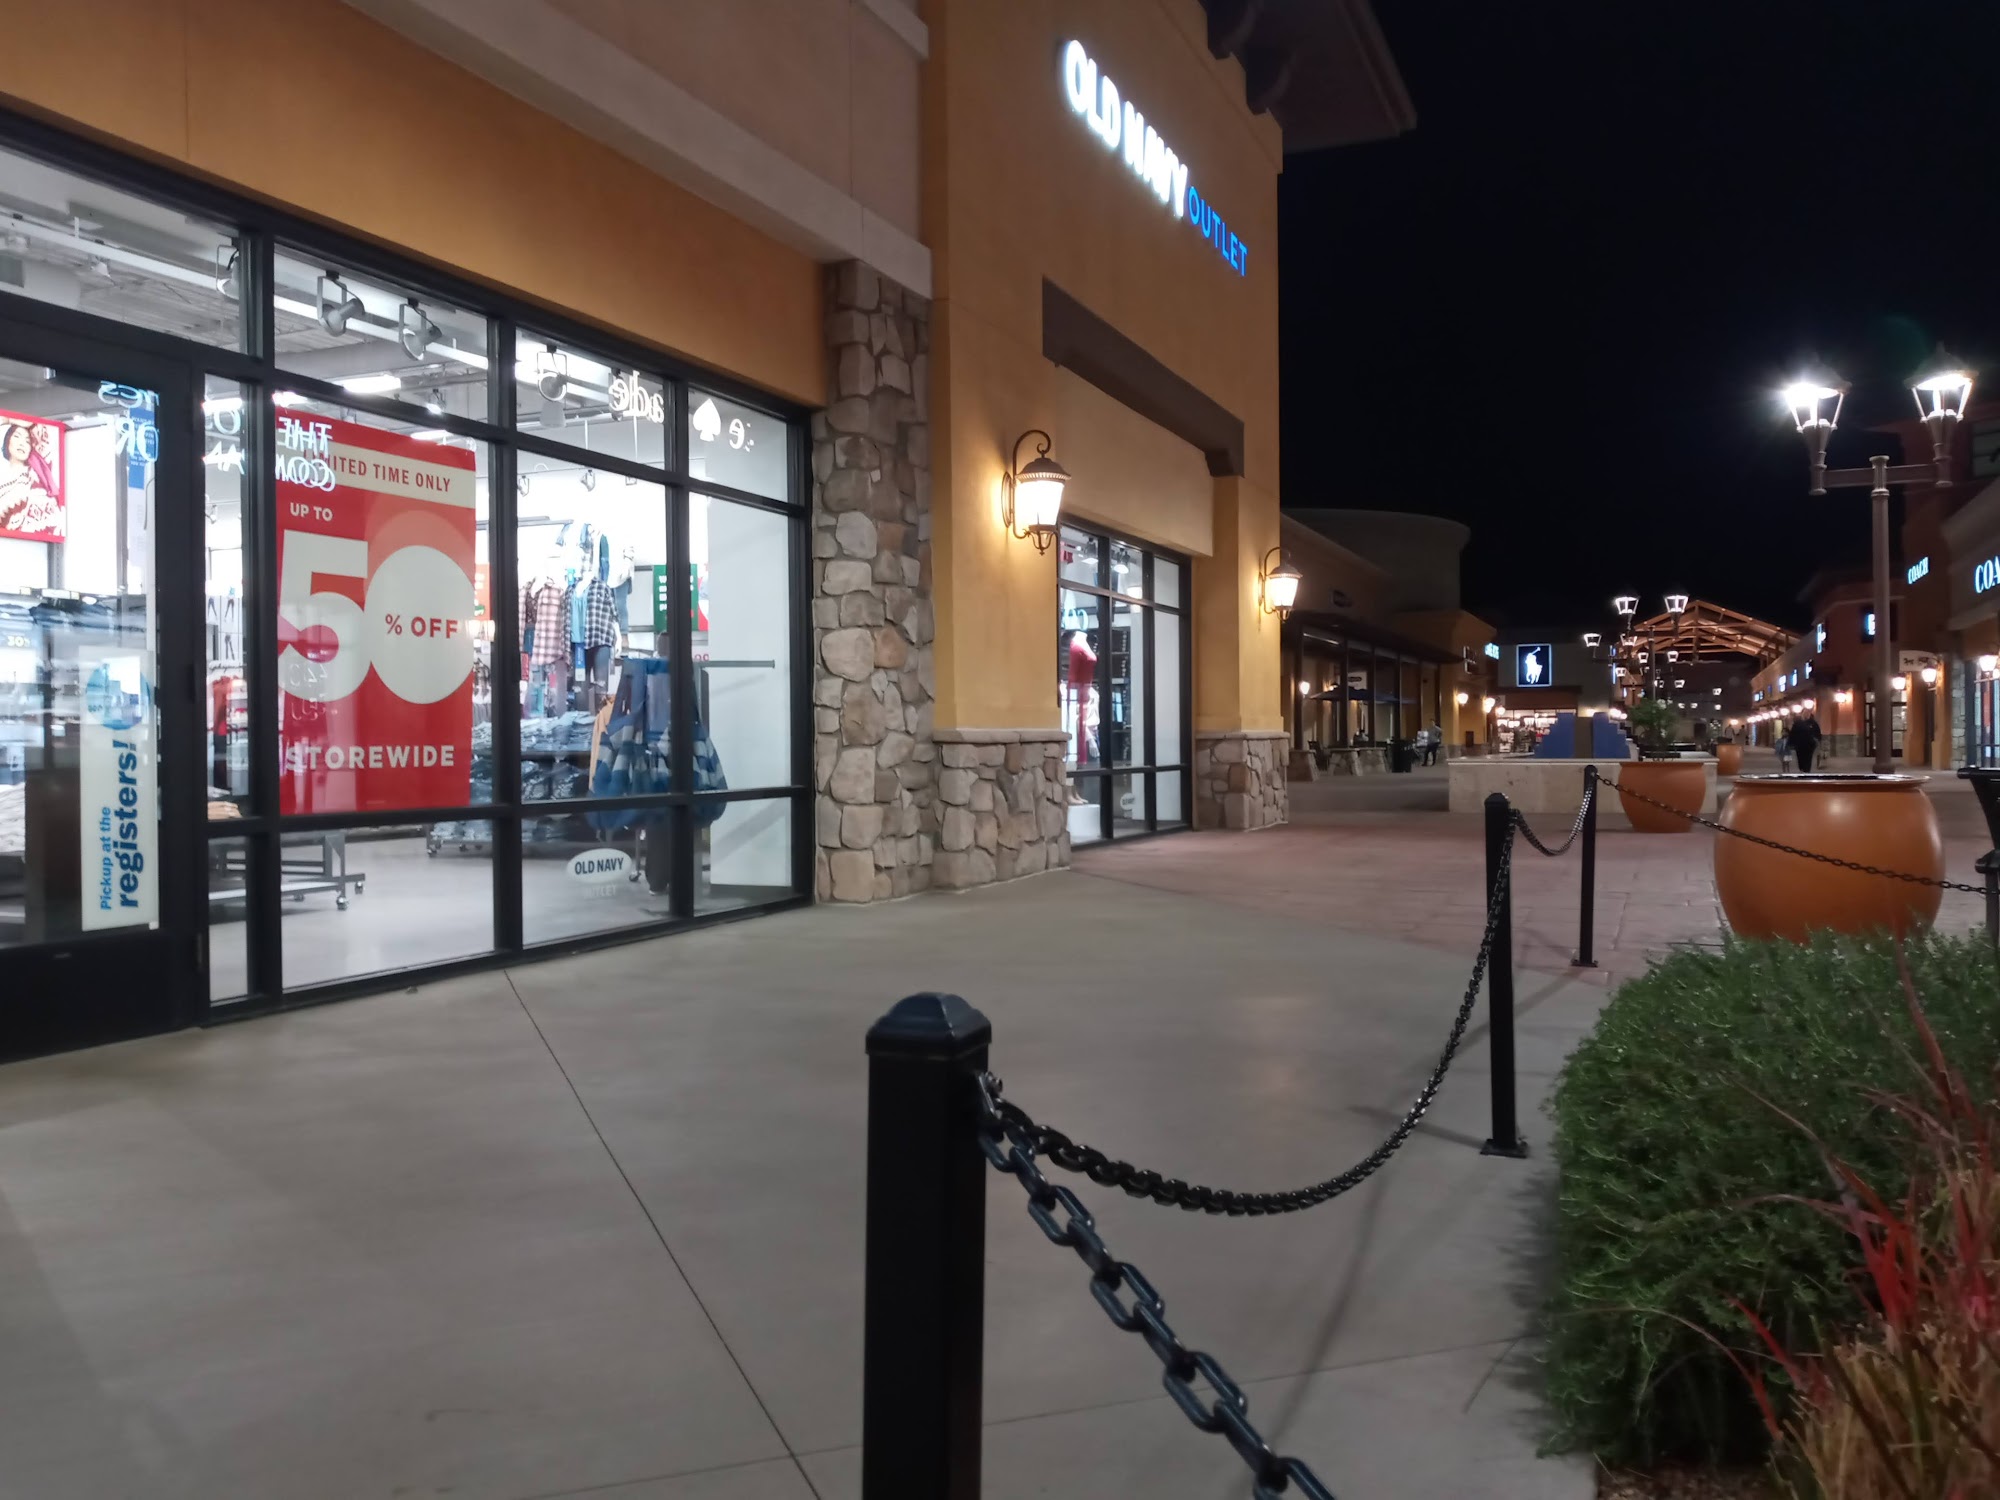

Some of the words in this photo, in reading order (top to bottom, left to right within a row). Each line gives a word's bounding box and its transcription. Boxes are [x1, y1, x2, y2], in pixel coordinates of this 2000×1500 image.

[1065, 39, 1122, 148] OLD
[1123, 100, 1188, 218] NAVY
[1188, 185, 1248, 276] OUTLET
[303, 449, 367, 476] ITED
[373, 463, 410, 485] TIME
[415, 473, 451, 492] ONLY
[290, 502, 310, 517] UP
[313, 506, 333, 521] TO
[1907, 557, 1929, 585] COACH
[277, 529, 476, 704] 50
[410, 615, 460, 639] OFF
[286, 745, 456, 771] STOREWIDE
[100, 807, 112, 832] the
[112, 739, 144, 908] registers!
[100, 836, 111, 853] at
[574, 860, 595, 875] OLD
[597, 857, 624, 873] NAVY
[100, 857, 114, 910] Pickup
